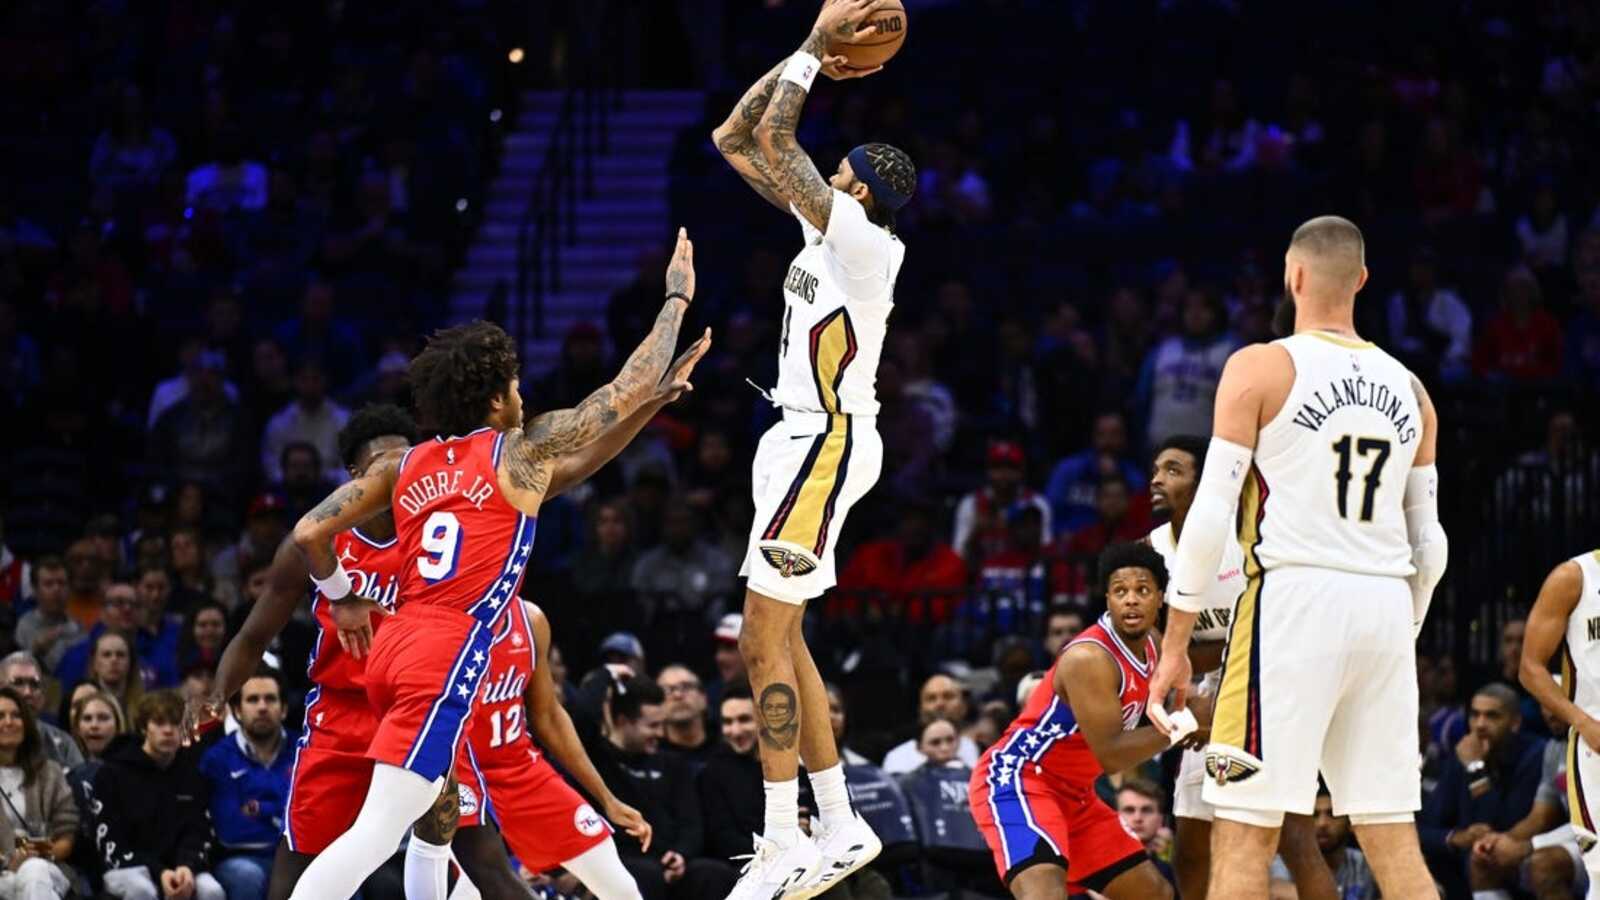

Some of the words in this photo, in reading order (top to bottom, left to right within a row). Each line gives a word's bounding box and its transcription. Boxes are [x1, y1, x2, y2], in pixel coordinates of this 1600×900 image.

[463, 475, 494, 510] JR
[1332, 434, 1391, 522] 17
[417, 511, 464, 585] 9
[489, 703, 524, 748] 12
